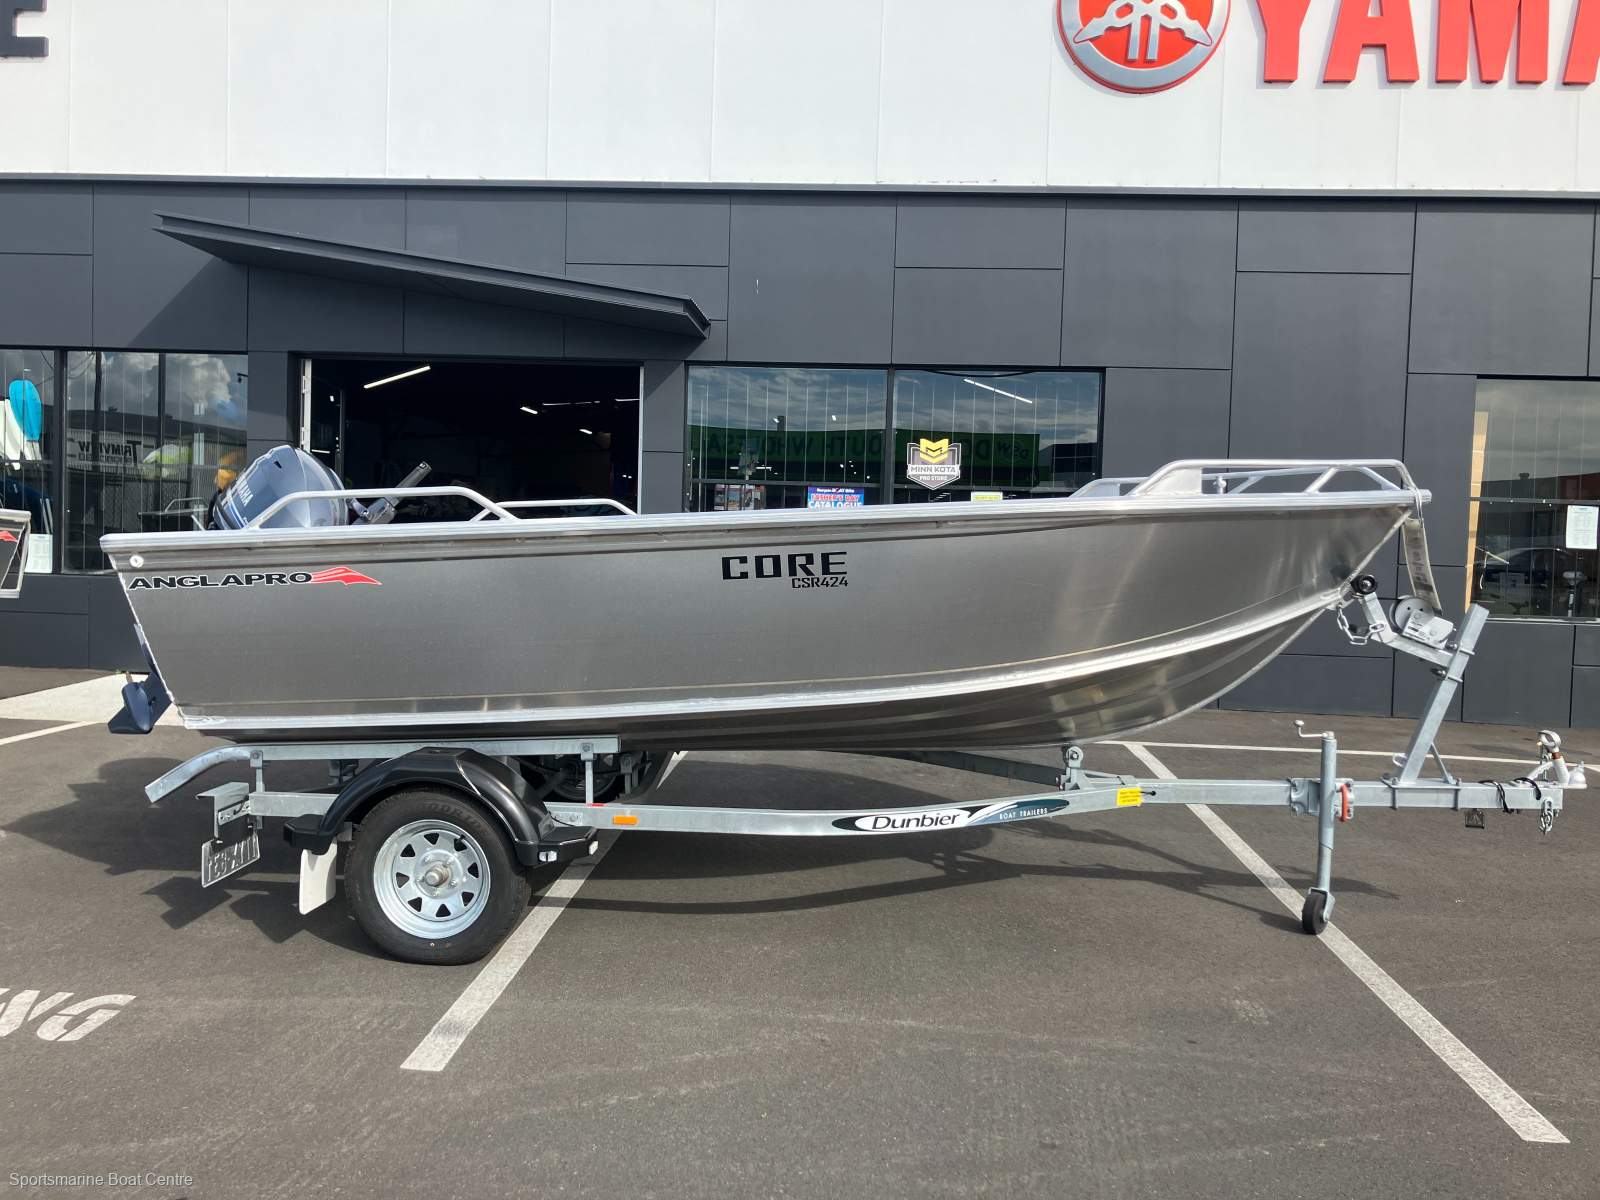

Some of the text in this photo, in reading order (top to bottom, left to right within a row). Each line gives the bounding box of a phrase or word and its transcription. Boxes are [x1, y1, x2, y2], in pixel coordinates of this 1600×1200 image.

[844, 494, 859, 502] DAY
[721, 551, 848, 580] CORE
[128, 572, 313, 590] ANGLAPRO
[791, 576, 849, 589] CSR424
[871, 812, 961, 830] Dunbier
[999, 807, 1049, 820] BOAT TRAILERS
